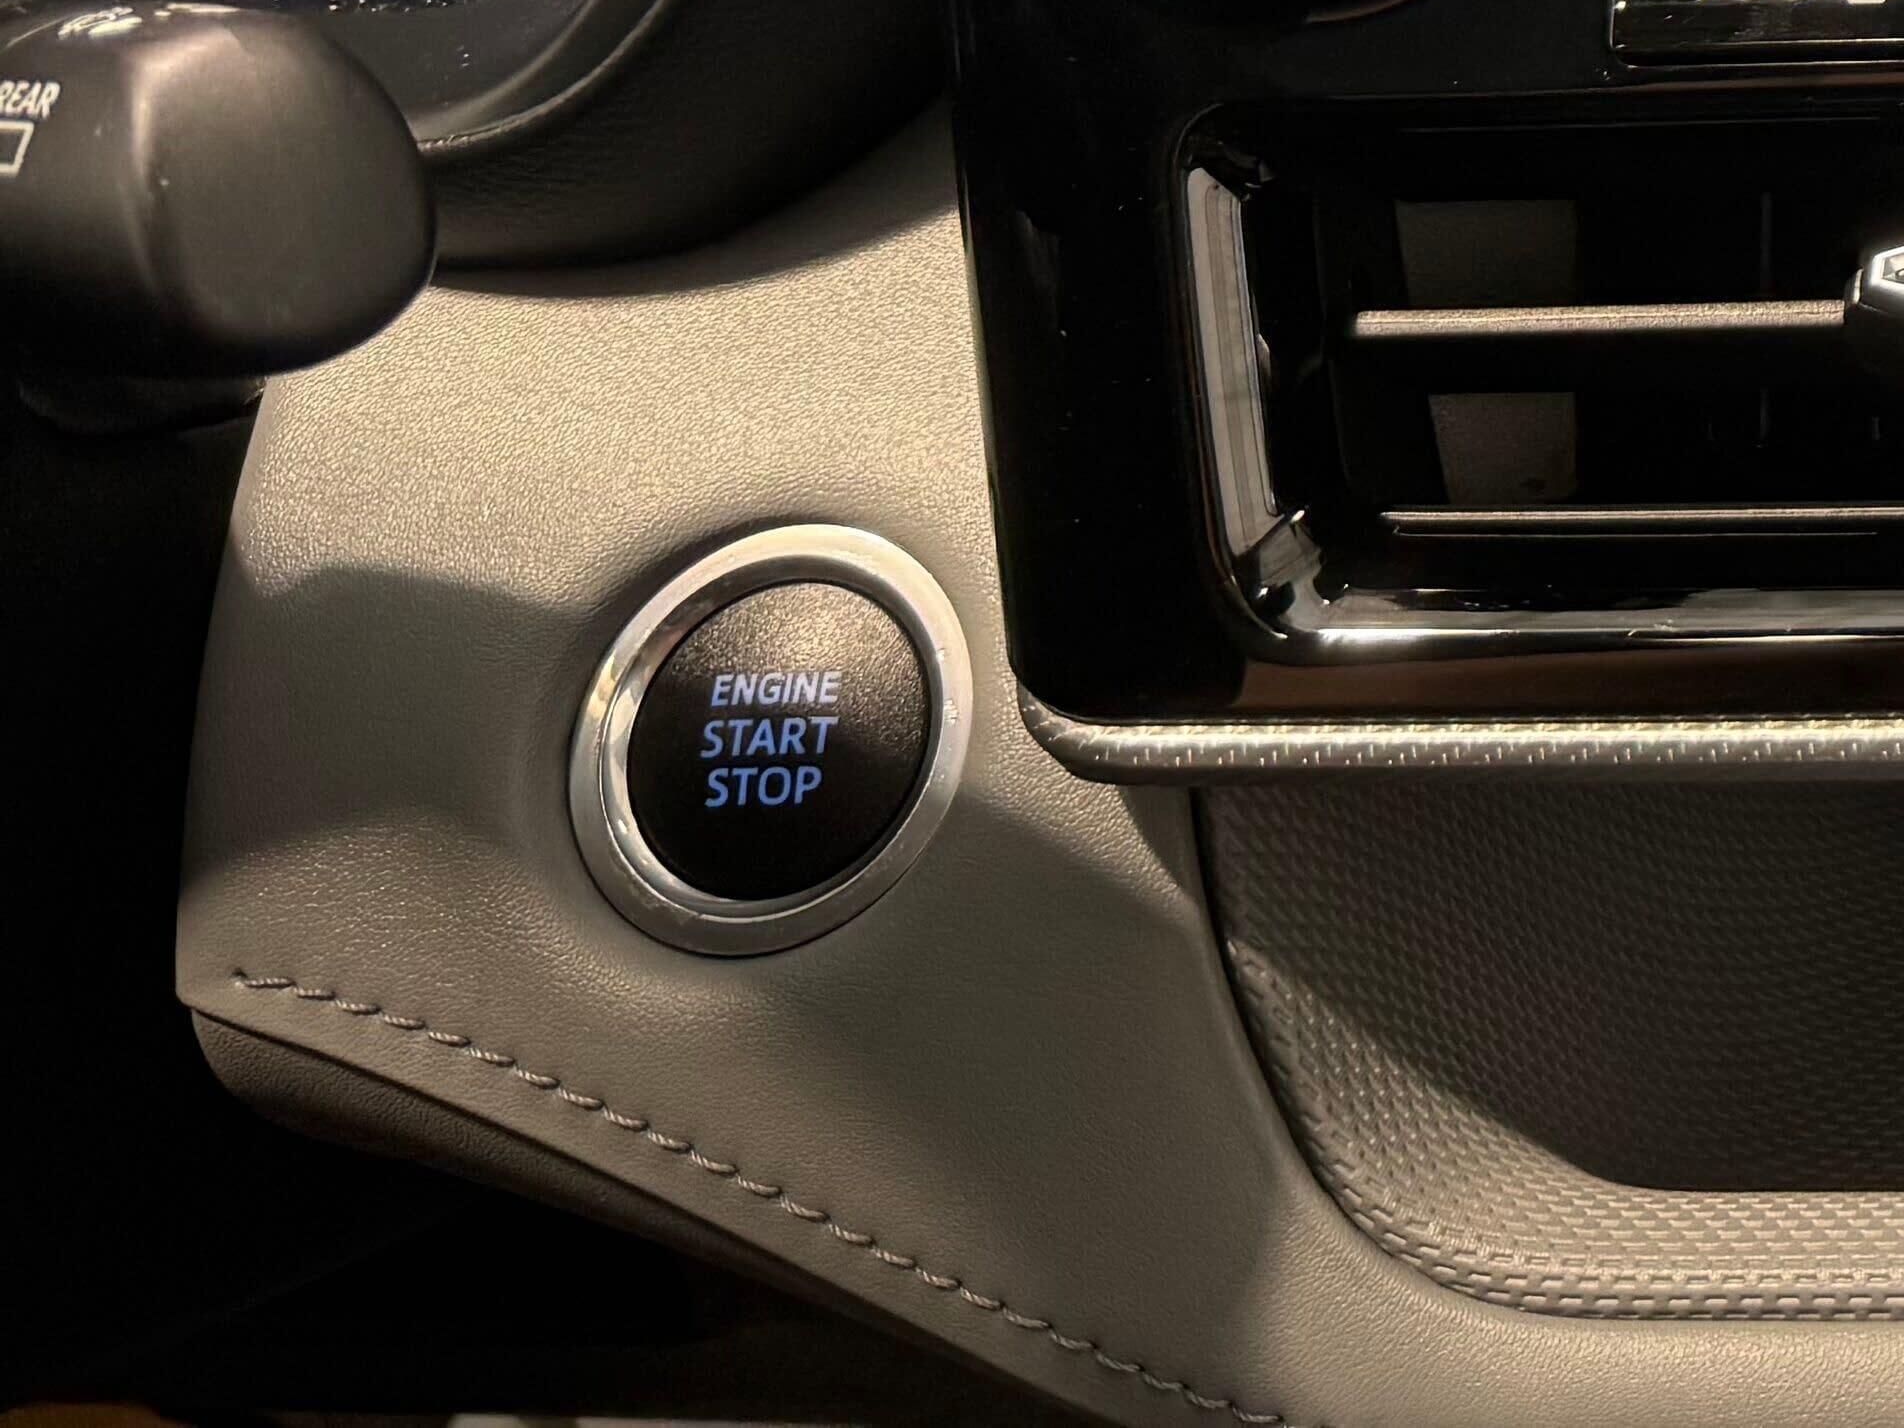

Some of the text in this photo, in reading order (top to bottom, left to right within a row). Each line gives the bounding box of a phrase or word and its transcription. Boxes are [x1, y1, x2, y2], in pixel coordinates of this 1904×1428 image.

[711, 670, 842, 707] ENGINE
[700, 715, 841, 759] START
[704, 764, 823, 808] STOP
